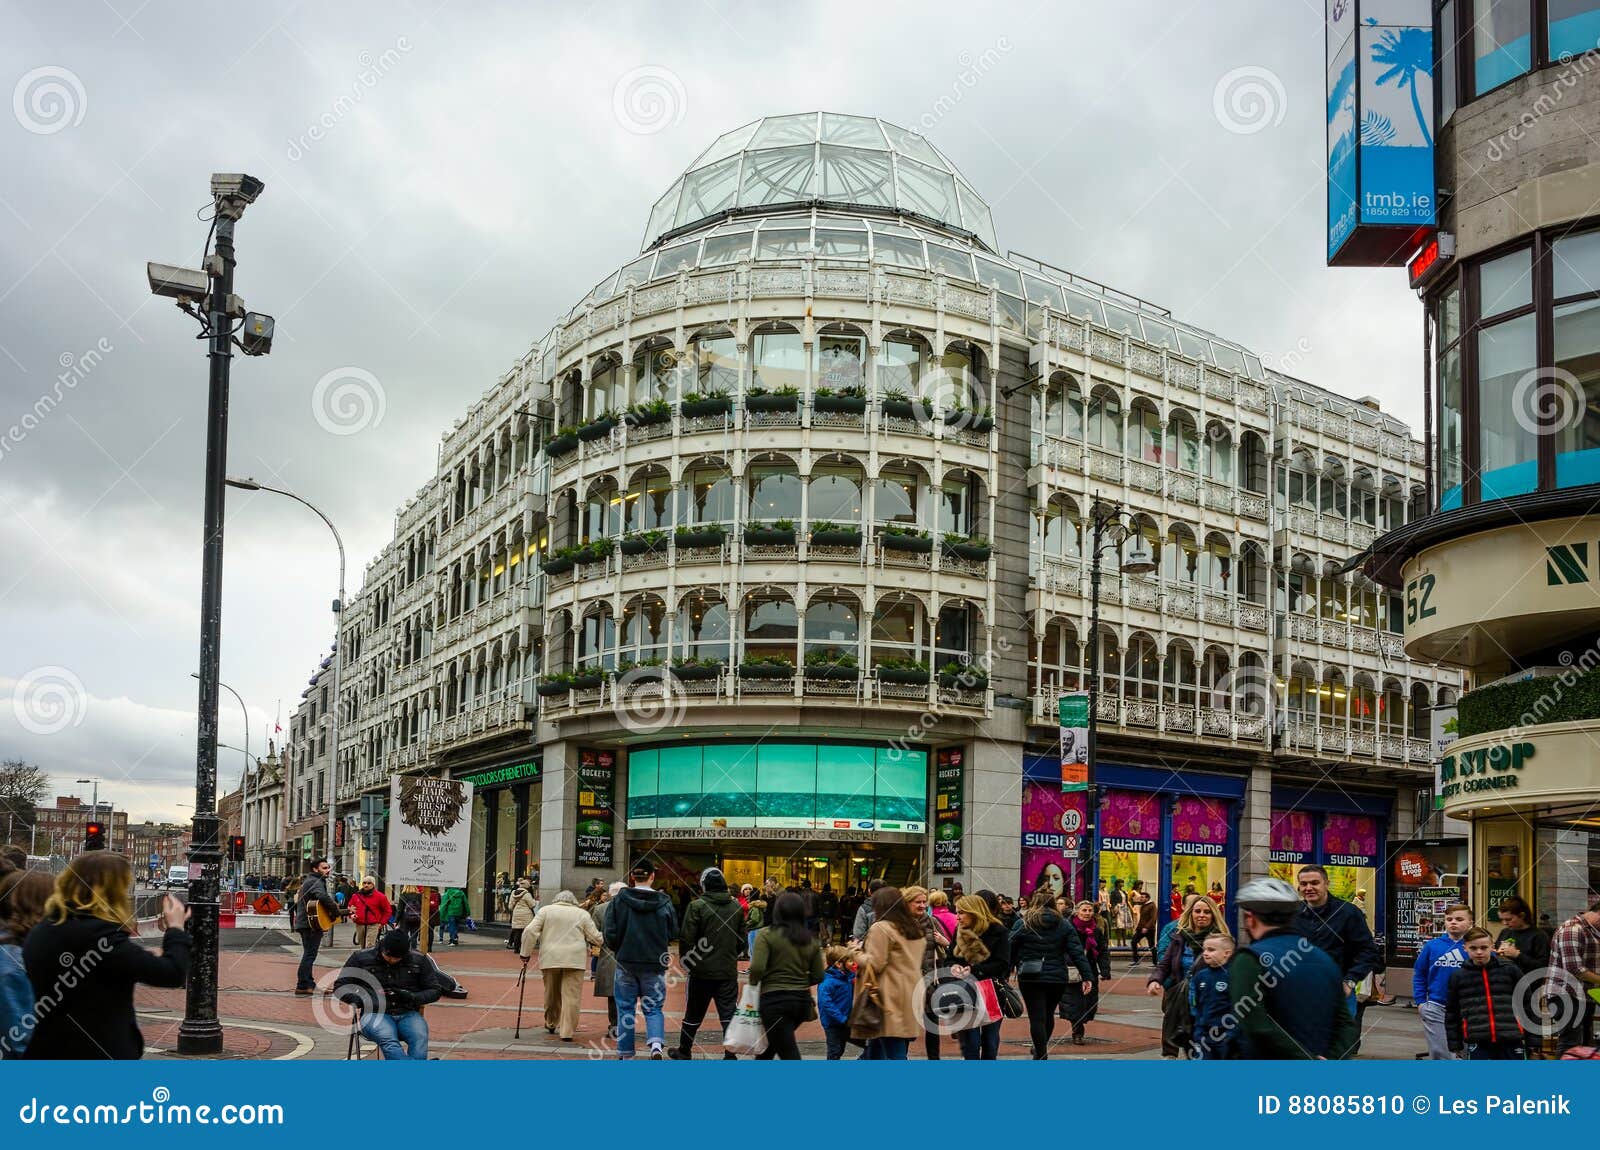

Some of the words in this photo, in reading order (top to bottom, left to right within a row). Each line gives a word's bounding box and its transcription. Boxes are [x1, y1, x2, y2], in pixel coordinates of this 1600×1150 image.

[1366, 192, 1430, 208] tmb.ie
[1366, 208, 1389, 216] 1850
[1391, 208, 1410, 216] 829
[1414, 209, 1431, 217] 100
[1407, 573, 1437, 625] 52
[1460, 742, 1536, 777] STOP
[416, 779, 451, 789] BADGER
[477, 772, 498, 785] COLORS
[1463, 774, 1518, 793] CORNER
[422, 787, 444, 796] HAIR
[413, 794, 452, 804] SHAVING
[418, 802, 446, 812] BRUSH
[420, 810, 442, 818] HELL
[1064, 813, 1077, 826] 30
[419, 817, 444, 826] YEAH!
[718, 829, 759, 838] GREEN
[761, 829, 825, 839] SHOPPING
[829, 831, 880, 841] CENTRE
[1025, 833, 1082, 848] swa
[1269, 851, 1304, 863] wamp
[1434, 960, 1463, 968] adida
